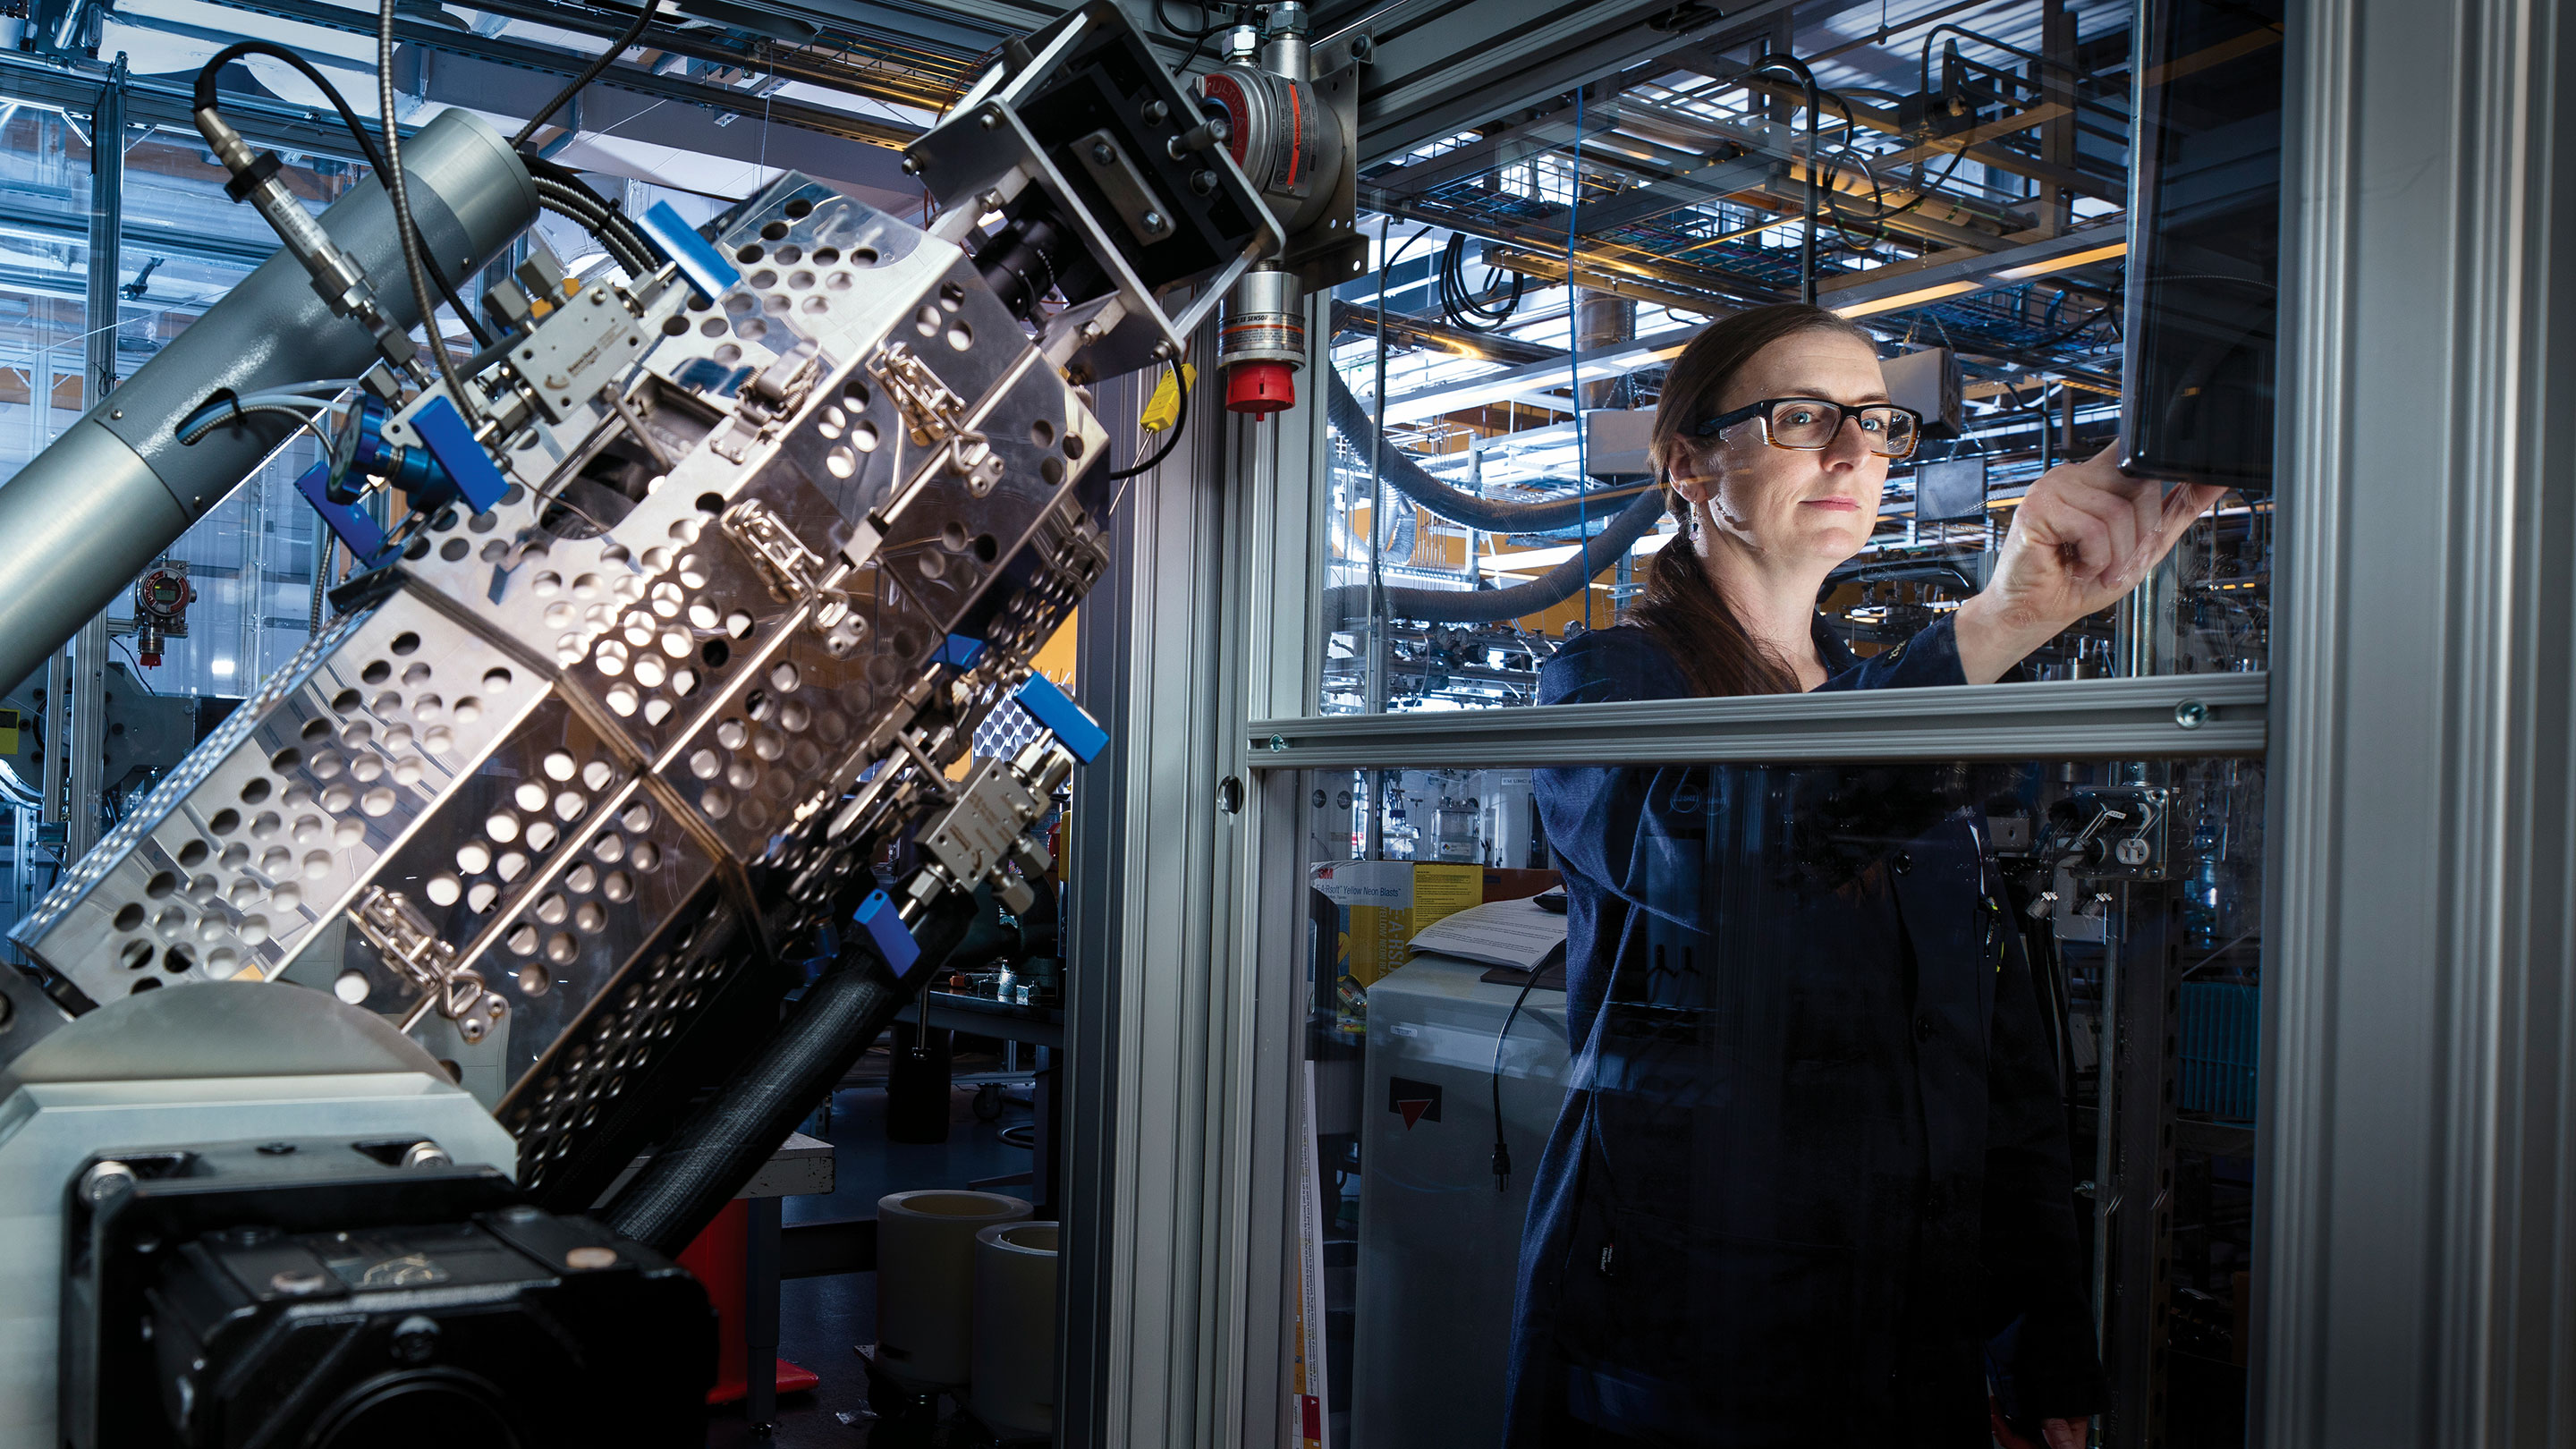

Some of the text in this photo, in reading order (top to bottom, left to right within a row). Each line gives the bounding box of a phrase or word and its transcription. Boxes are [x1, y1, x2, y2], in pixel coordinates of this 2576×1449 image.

[1318, 868, 1334, 880] 3M
[1343, 886, 1362, 895] Yellow
[1363, 886, 1379, 896] Neon
[1378, 906, 1387, 979] YELLOW NEON BLA
